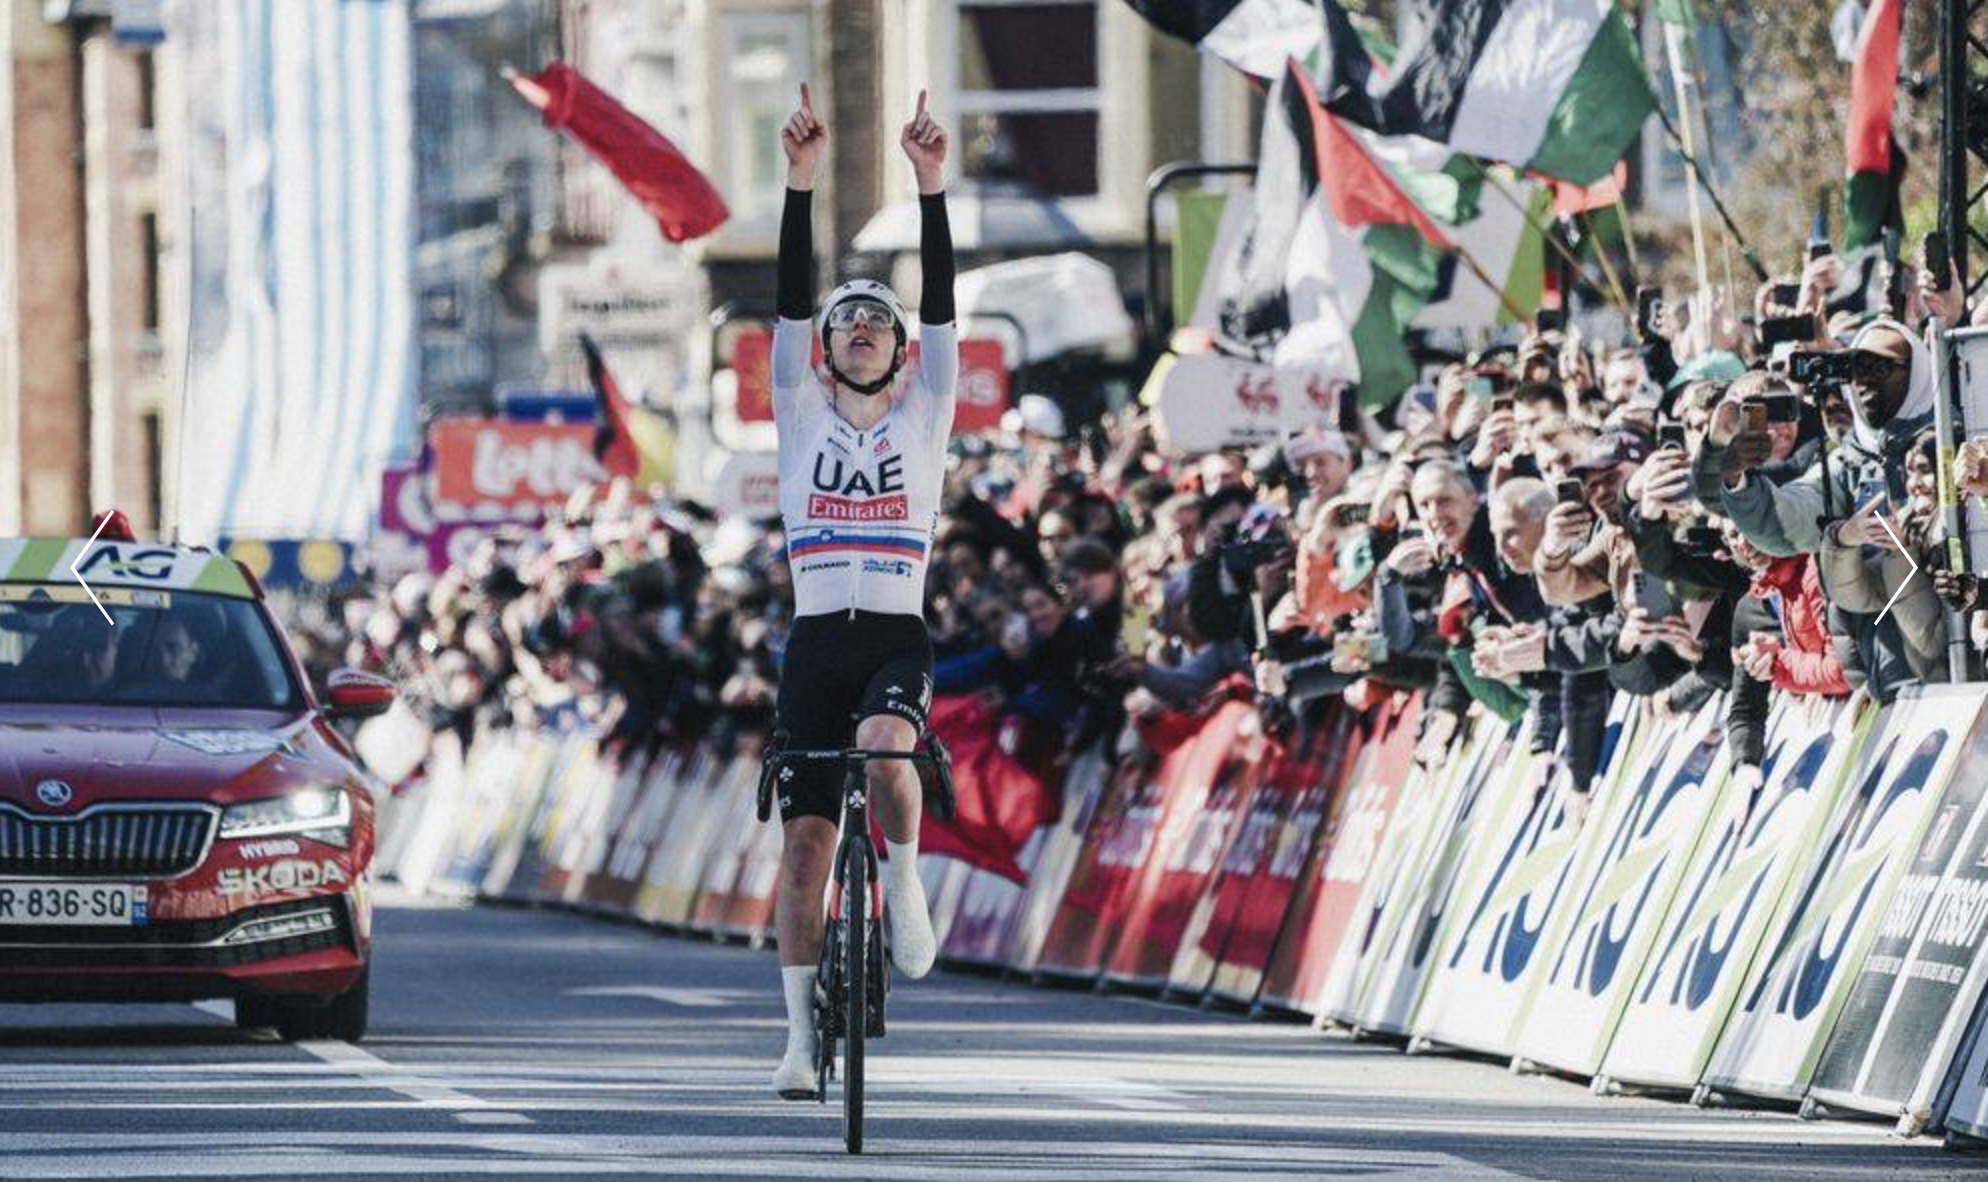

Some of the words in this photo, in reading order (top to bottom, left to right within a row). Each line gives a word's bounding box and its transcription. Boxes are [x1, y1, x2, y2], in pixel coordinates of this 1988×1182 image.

[813, 450, 905, 497] UAE
[810, 496, 906, 521] Emirates
[78, 544, 177, 580] AG
[239, 839, 300, 860] HYBRID
[1549, 727, 1725, 998] AG
[1744, 728, 1950, 1022] AG
